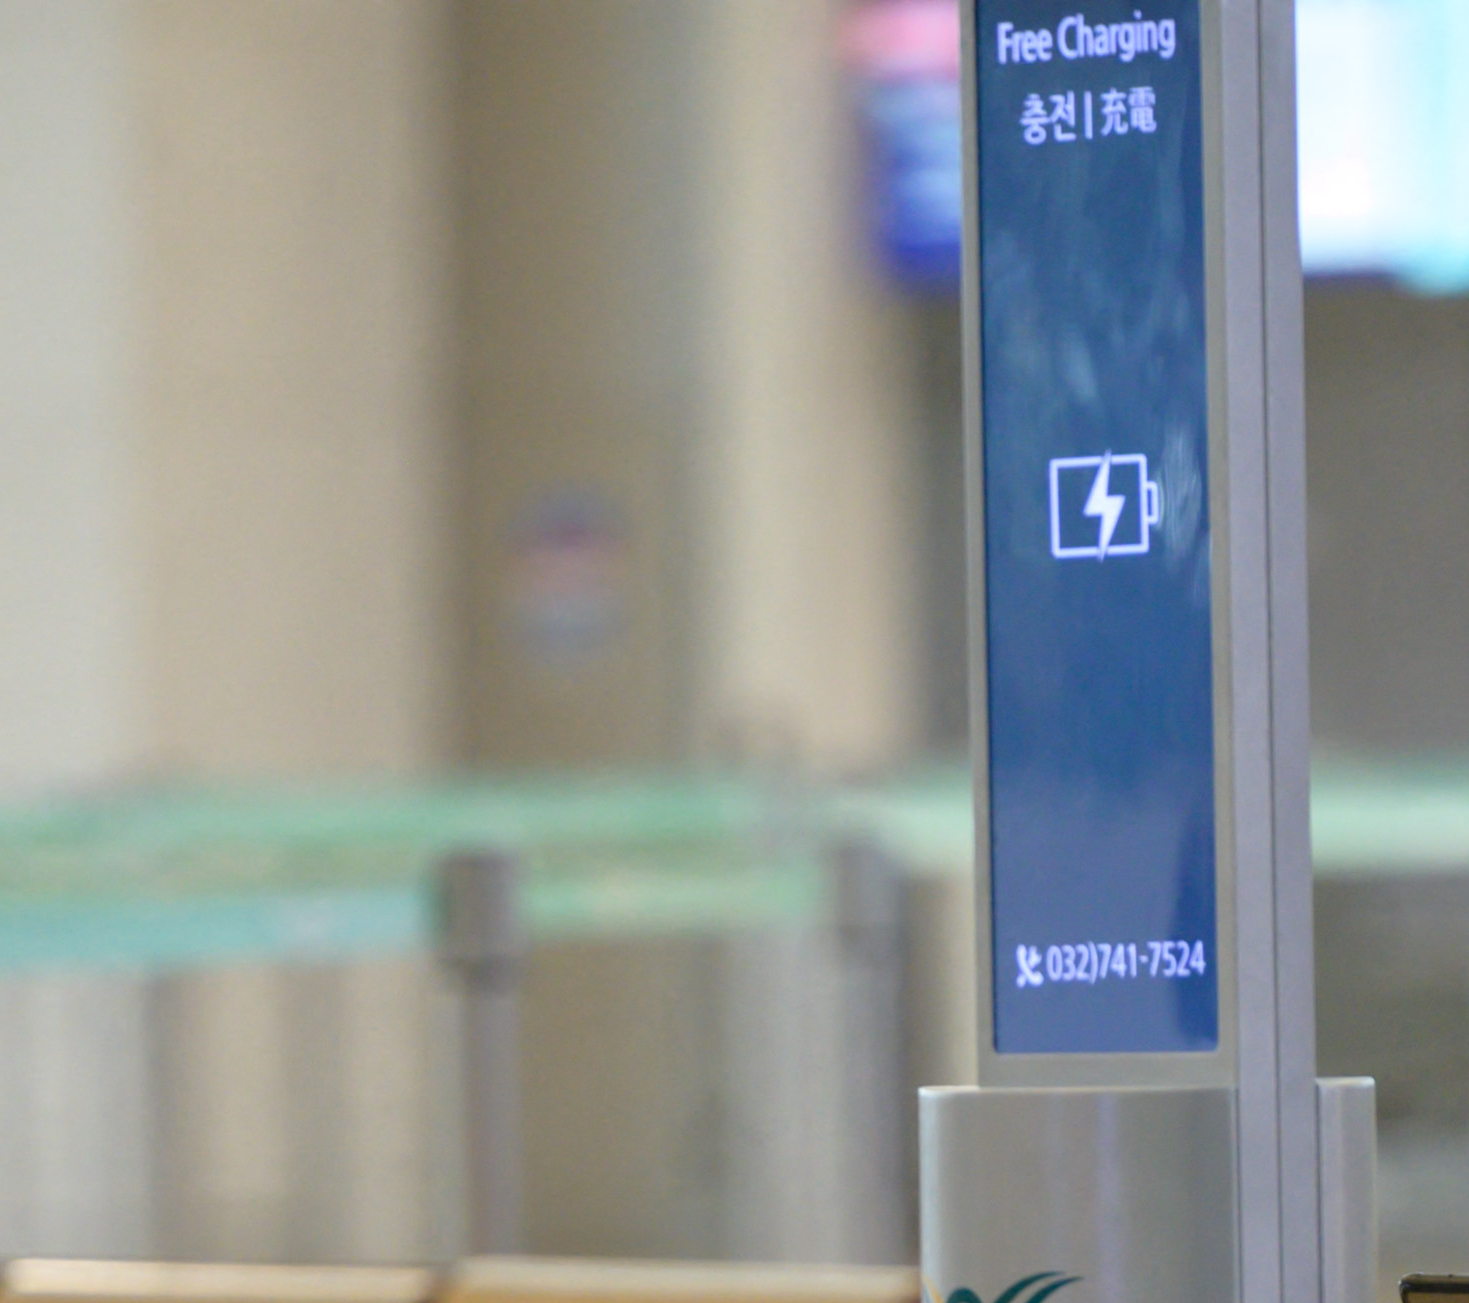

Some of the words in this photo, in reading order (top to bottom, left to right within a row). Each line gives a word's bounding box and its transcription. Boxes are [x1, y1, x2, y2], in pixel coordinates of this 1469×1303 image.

[997, 21, 1053, 64] Free
[1057, 9, 1176, 62] Charging
[1019, 90, 1077, 145] 충전
[1100, 86, 1157, 136] 充電
[1046, 940, 1206, 984] 032)741-7524
